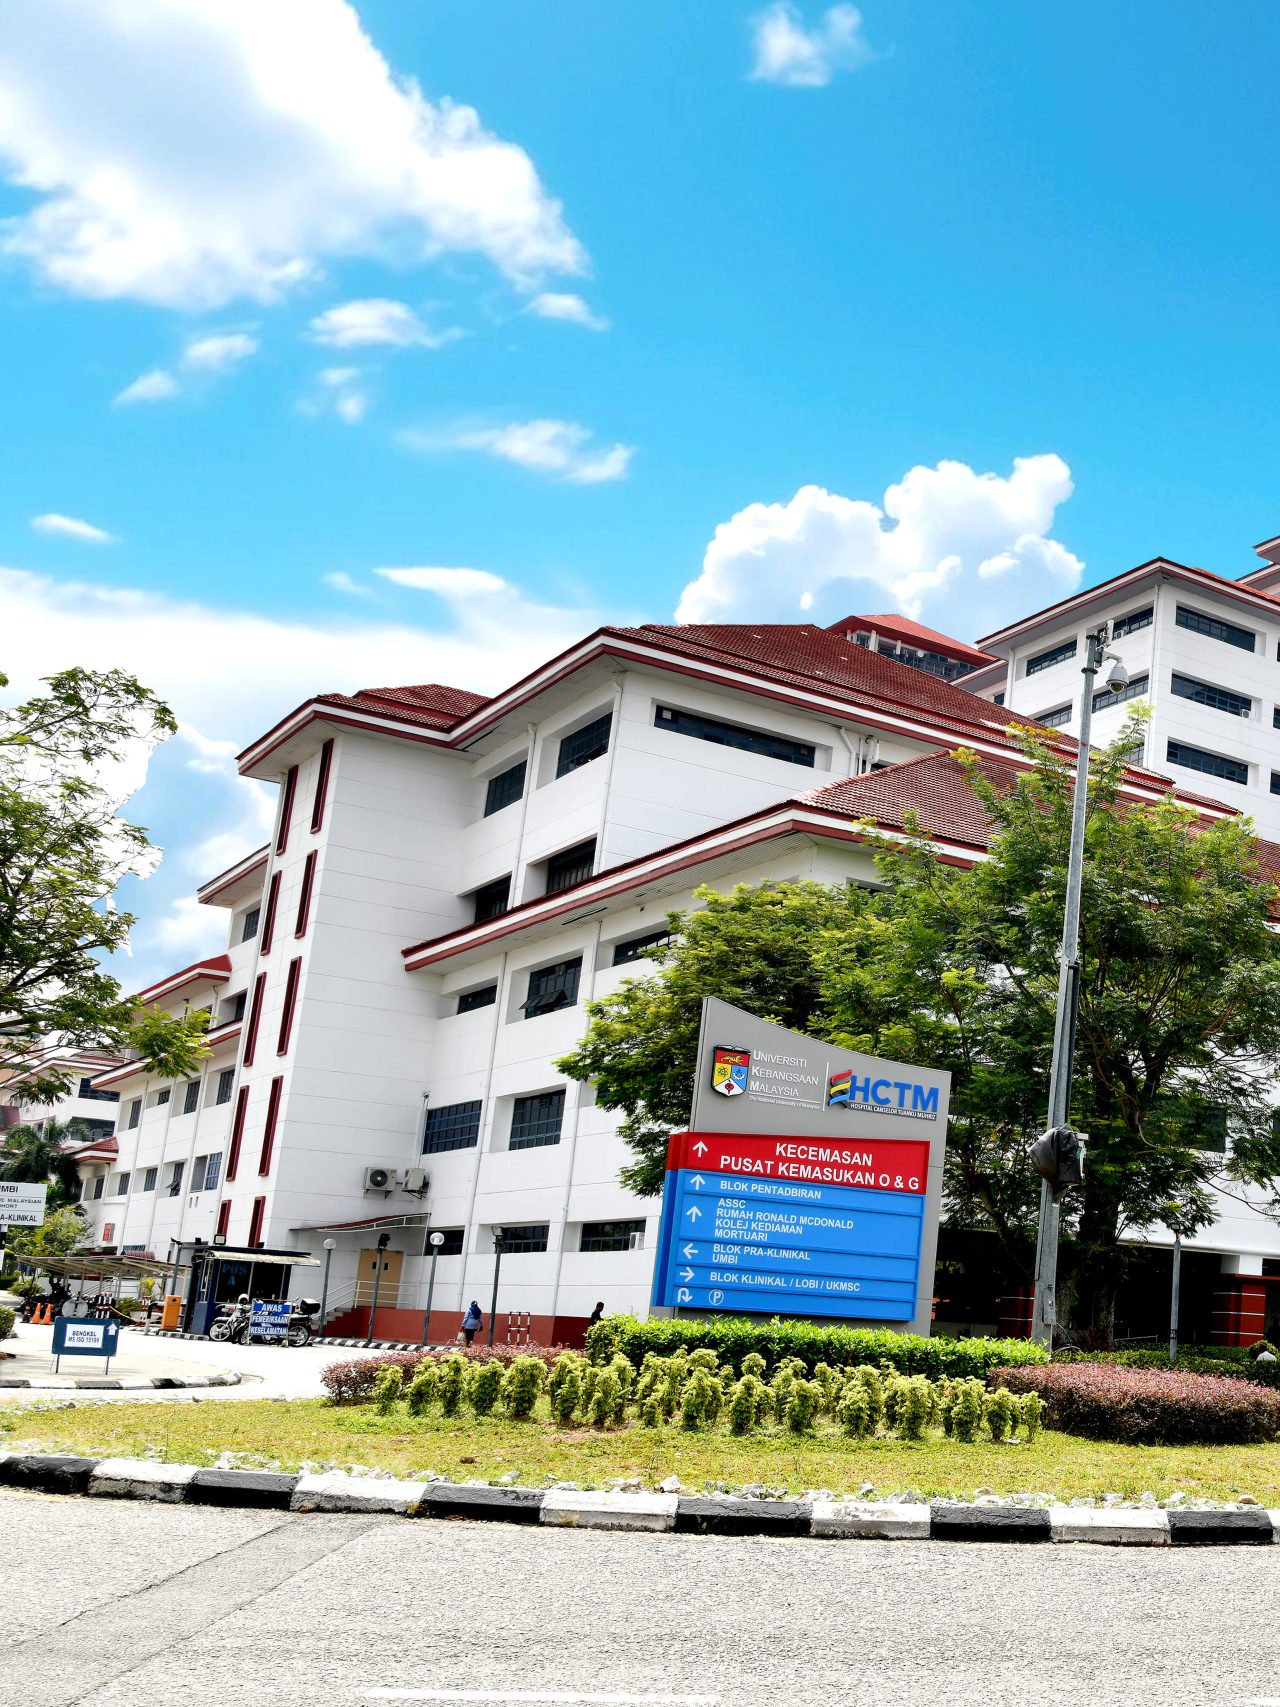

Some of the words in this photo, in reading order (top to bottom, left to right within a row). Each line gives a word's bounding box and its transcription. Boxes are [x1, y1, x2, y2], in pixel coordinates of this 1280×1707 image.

[753, 1050, 807, 1068] UNIVERSITI
[752, 1066, 819, 1085] KEBANGSAAN
[750, 1081, 799, 1097] MALAYSIA
[851, 1075, 939, 1112] HCTM
[851, 1103, 873, 1111] HOSPITAL
[874, 1106, 897, 1115] CANSELOR
[776, 1143, 872, 1166] KECEMASAN
[720, 1156, 774, 1174] PUSAT
[778, 1162, 875, 1185] KEMASUKAN
[879, 1174, 890, 1187] O
[895, 1176, 904, 1188] &
[909, 1177, 919, 1189] G
[720, 1181, 749, 1192] BLOK
[752, 1184, 822, 1199] PENTADBIRAN
[718, 1198, 746, 1209] ASSC
[716, 1218, 749, 1230] KOLEJ
[751, 1223, 803, 1234] KEDIAMAN
[717, 1208, 752, 1220] RUMAH
[756, 1212, 797, 1224] RONALD
[800, 1217, 854, 1229] MCDONALD
[715, 1229, 768, 1242] MORTUARI
[712, 1254, 738, 1265] UMBI
[713, 1243, 741, 1255] BLOK
[744, 1247, 811, 1260] PRA-KLINIKAL
[710, 1272, 738, 1283] BLOK
[741, 1275, 787, 1287] KLINIKAL
[796, 1279, 819, 1289] LOBI
[826, 1281, 861, 1292] UKMSC
[262, 1304, 282, 1312] AWAS
[252, 1315, 288, 1324] PEMERIKSAAN
[250, 1326, 288, 1336] KESELAMATAN
